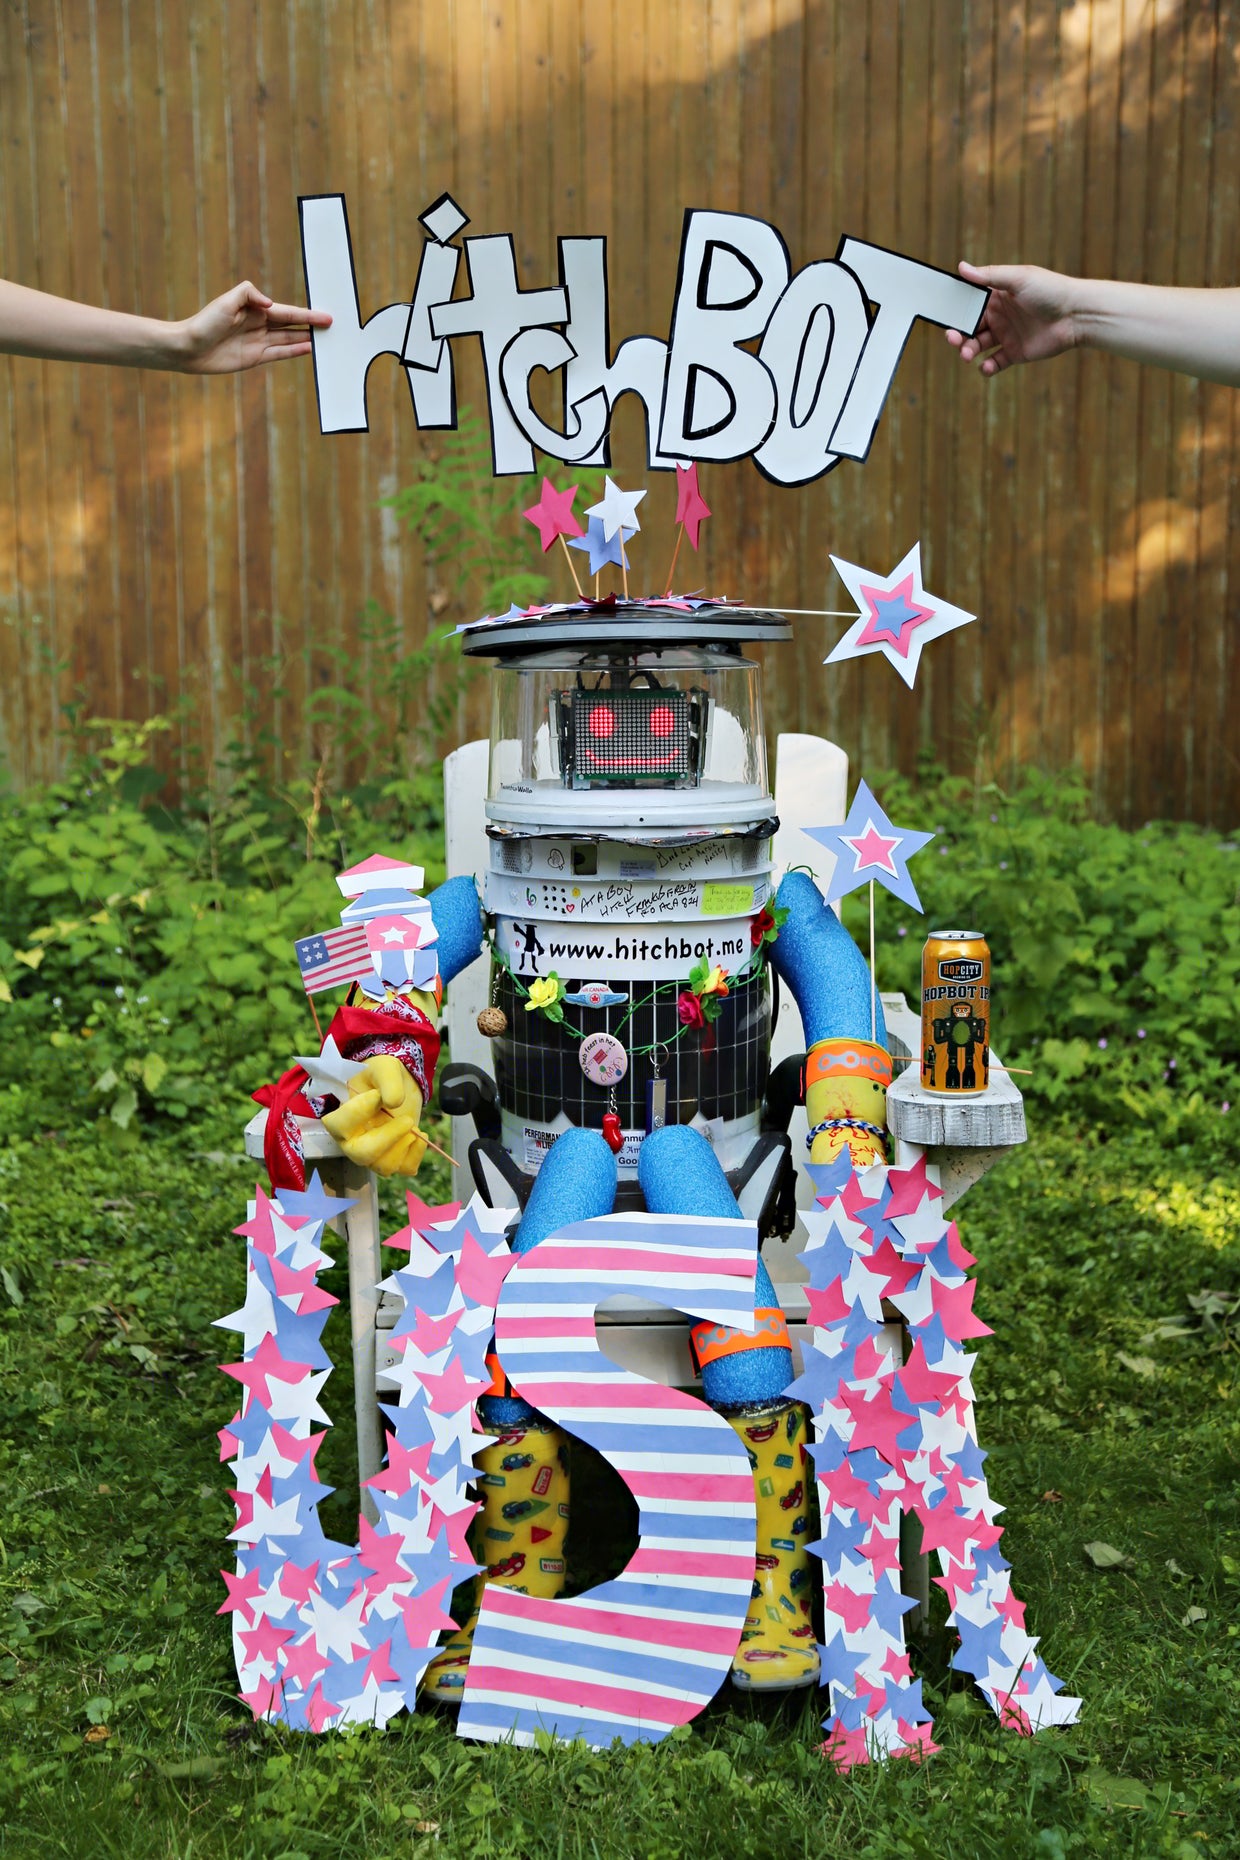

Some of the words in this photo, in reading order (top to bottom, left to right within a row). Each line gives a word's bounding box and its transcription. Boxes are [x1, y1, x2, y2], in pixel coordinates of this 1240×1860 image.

[298, 192, 992, 488] hitchBOT
[550, 937, 743, 960] www.hitchbot.me
[924, 985, 977, 1001] HOPBOT
[980, 986, 990, 1000] IP
[524, 1127, 561, 1142] PERFORMAN
